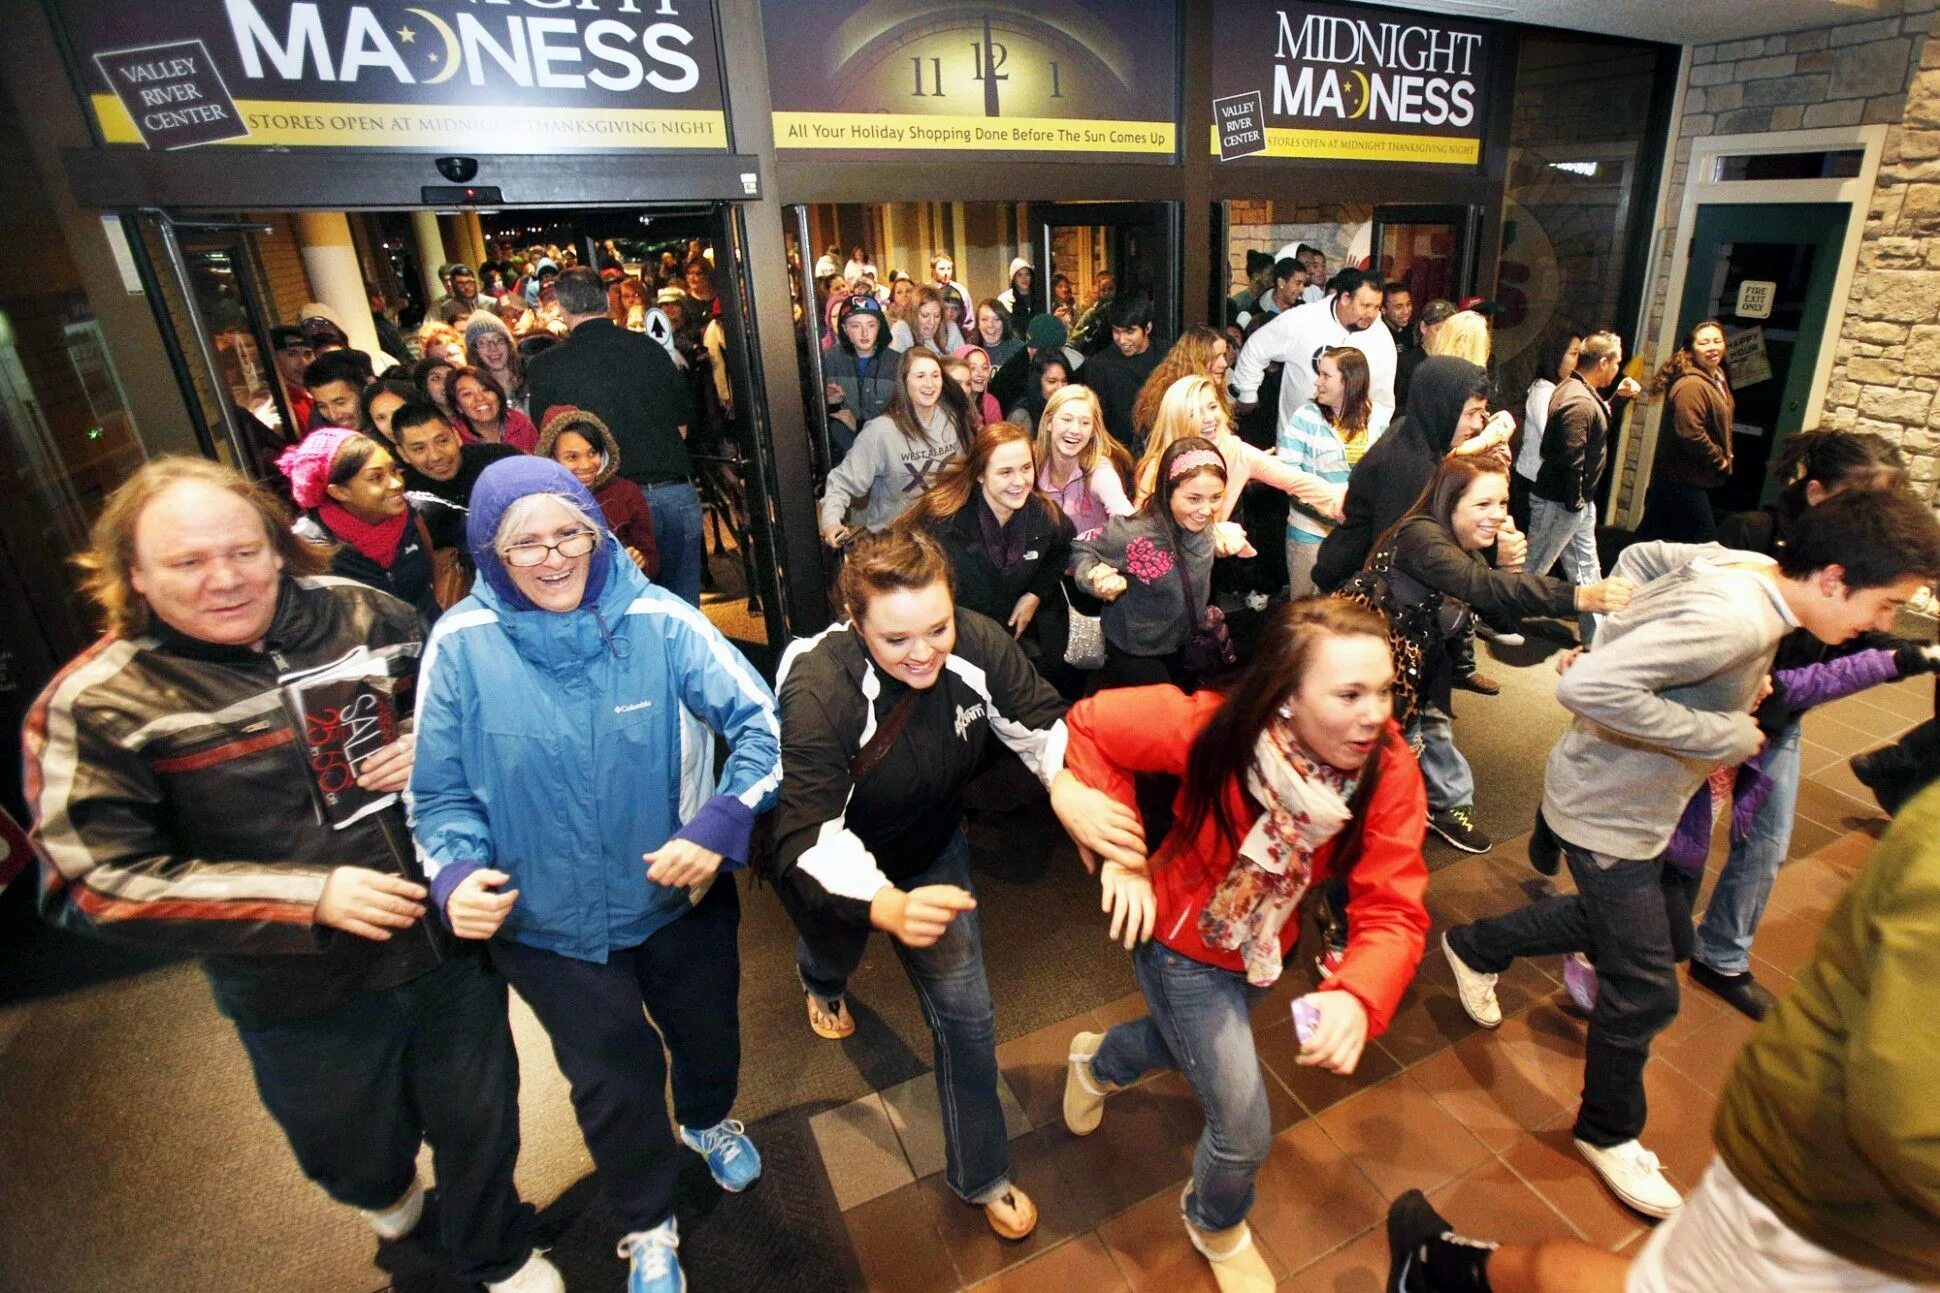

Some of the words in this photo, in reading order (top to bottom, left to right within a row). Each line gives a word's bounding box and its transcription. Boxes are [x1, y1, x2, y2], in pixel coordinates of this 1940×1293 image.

[225, 0, 700, 94] MADNESS
[1274, 10, 1482, 76] MIDNIGHT
[120, 57, 198, 83] VALLEY
[970, 42, 1010, 80] 12
[911, 57, 946, 97] 11
[1049, 61, 1064, 98] 1
[140, 83, 203, 107] RIVER
[1272, 64, 1476, 127] MADNESS
[144, 104, 229, 131] CENTER
[1222, 101, 1254, 118] VALLEY
[249, 114, 325, 130] STORES
[331, 115, 385, 131] OPEN
[391, 117, 413, 131] AT
[419, 119, 520, 133] MIDNI
[527, 119, 656, 134] THANKSGIVING
[662, 121, 715, 135] NIGHT
[788, 124, 808, 138] All
[812, 124, 846, 138] Your
[851, 125, 904, 141] Holiday
[909, 126, 971, 142] Shopping
[975, 127, 1008, 140] Done
[1012, 128, 1054, 142] Before
[1057, 129, 1081, 142] The
[1084, 130, 1106, 142] Sun
[1109, 131, 1147, 144] Comes
[1150, 132, 1165, 146] Up
[1226, 117, 1253, 132] RIVER
[1223, 130, 1260, 147] CENTER
[1267, 136, 1300, 147] STORES
[1302, 138, 1326, 149] OPEN
[1329, 139, 1340, 150] AT
[1341, 140, 1386, 152] MIDNIGHT
[1388, 142, 1448, 154] THANKSGIVING
[1449, 145, 1475, 156] NIGHT
[1744, 295, 1766, 303] EXIT
[1745, 286, 1768, 296] FIRE
[1742, 302, 1764, 312] ONLY
[1730, 343, 1758, 359] HOUR
[901, 450, 928, 461] WEST
